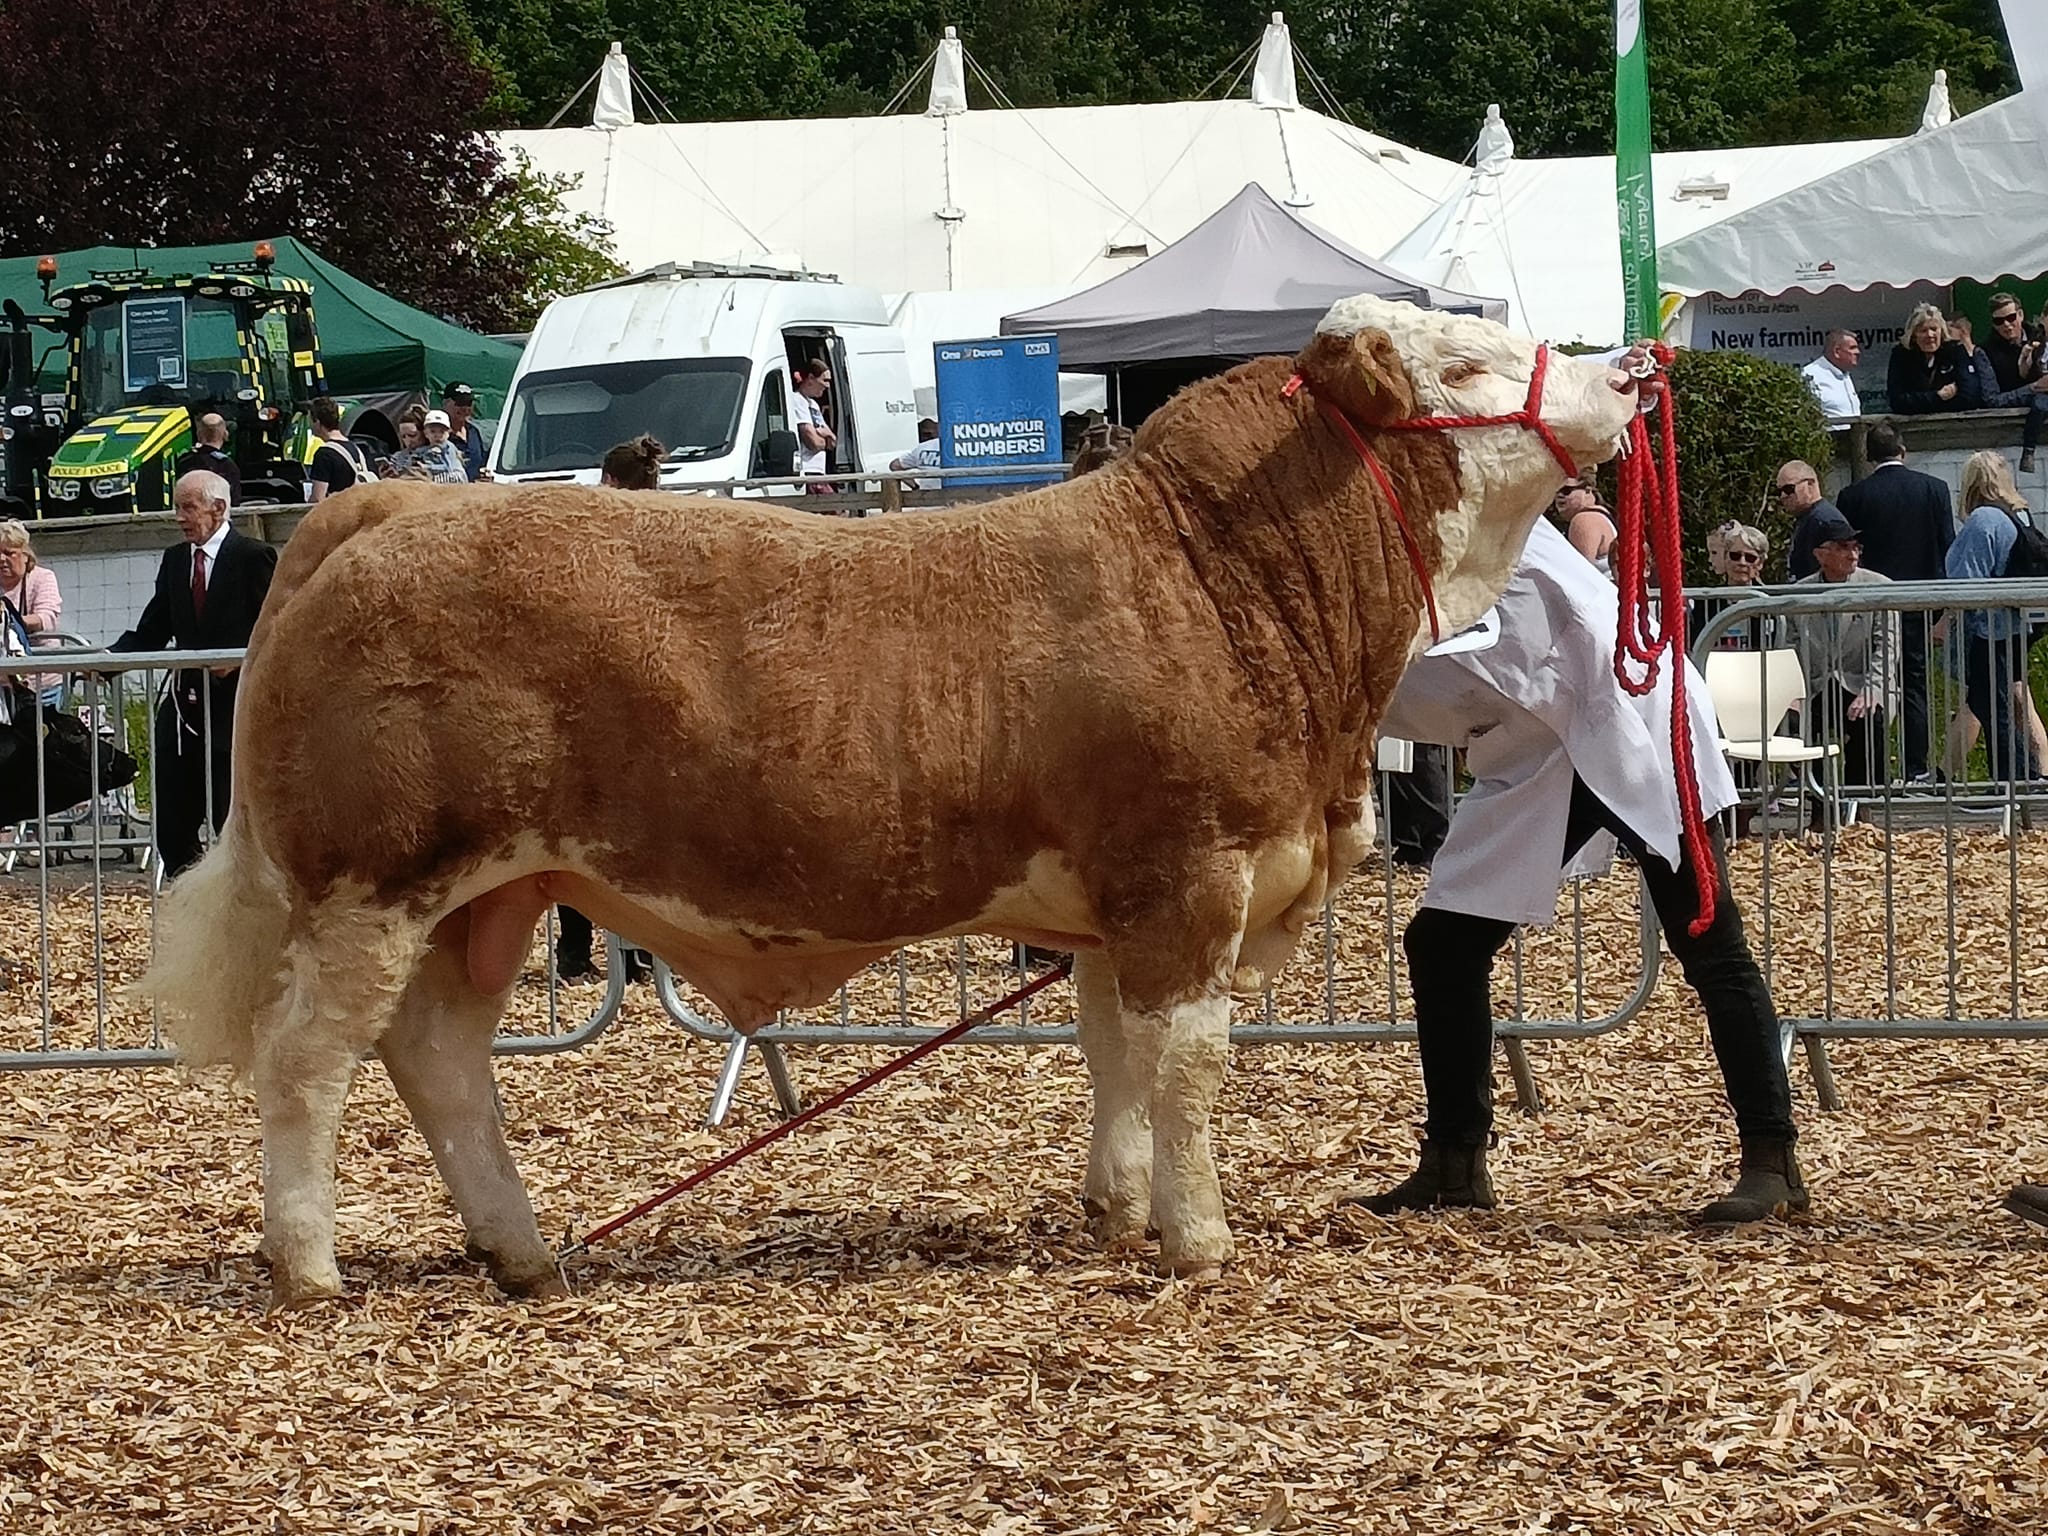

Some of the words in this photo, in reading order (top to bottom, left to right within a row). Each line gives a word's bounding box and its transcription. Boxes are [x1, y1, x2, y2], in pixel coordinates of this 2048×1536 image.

[1713, 304, 1736, 315] Food
[1711, 329, 1754, 349] New
[1759, 325, 1829, 348] farmin
[941, 350, 961, 360] One
[972, 348, 1004, 358] Devon
[1026, 344, 1049, 355] NHS
[953, 423, 1005, 439] KNOW
[1005, 420, 1044, 433] YOUR
[954, 438, 1046, 457] NUMBERS!
[53, 467, 80, 476] POLICE
[89, 464, 122, 474] POLICE
